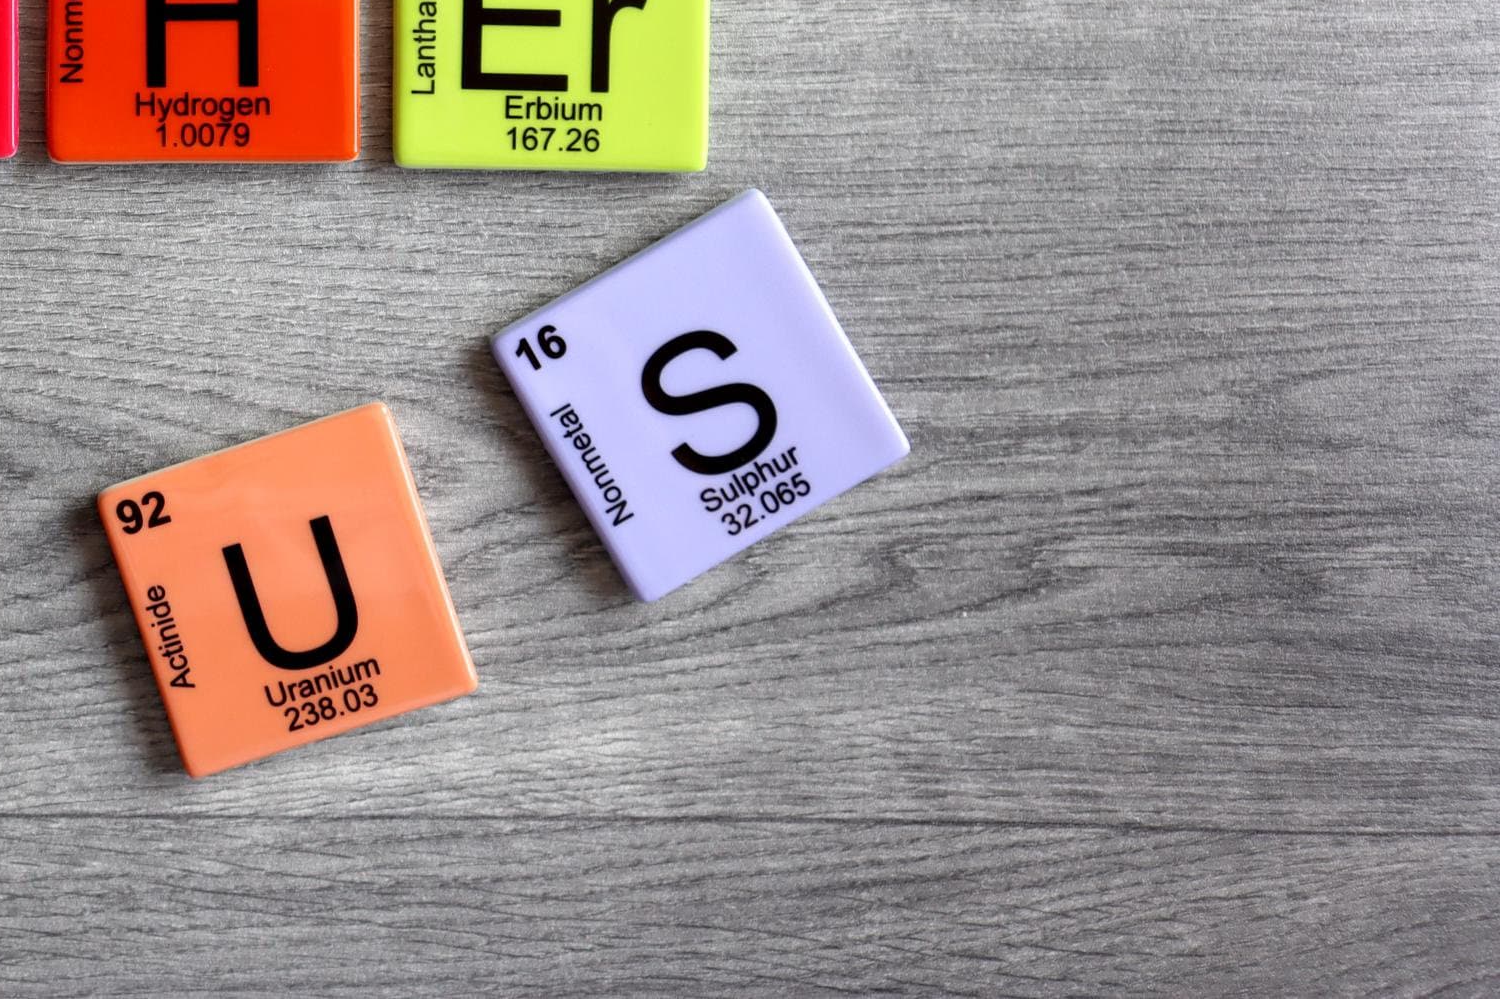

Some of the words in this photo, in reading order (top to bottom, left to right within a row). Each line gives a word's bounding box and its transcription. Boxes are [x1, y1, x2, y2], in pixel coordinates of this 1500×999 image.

[135, 92, 271, 123] Hydrogen
[504, 94, 603, 122] Erbium
[156, 122, 251, 148] 1.0079
[506, 126, 600, 153] 167.26
[515, 324, 567, 371] 16
[640, 329, 778, 476] S
[549, 403, 635, 527] Nonmetal
[699, 446, 799, 513] Sulphur
[115, 490, 172, 535] 92
[720, 471, 811, 536] 32.065
[221, 514, 359, 671] U
[145, 584, 196, 689] Actinide
[264, 658, 381, 708] Uranium
[283, 683, 379, 733] 238.03
